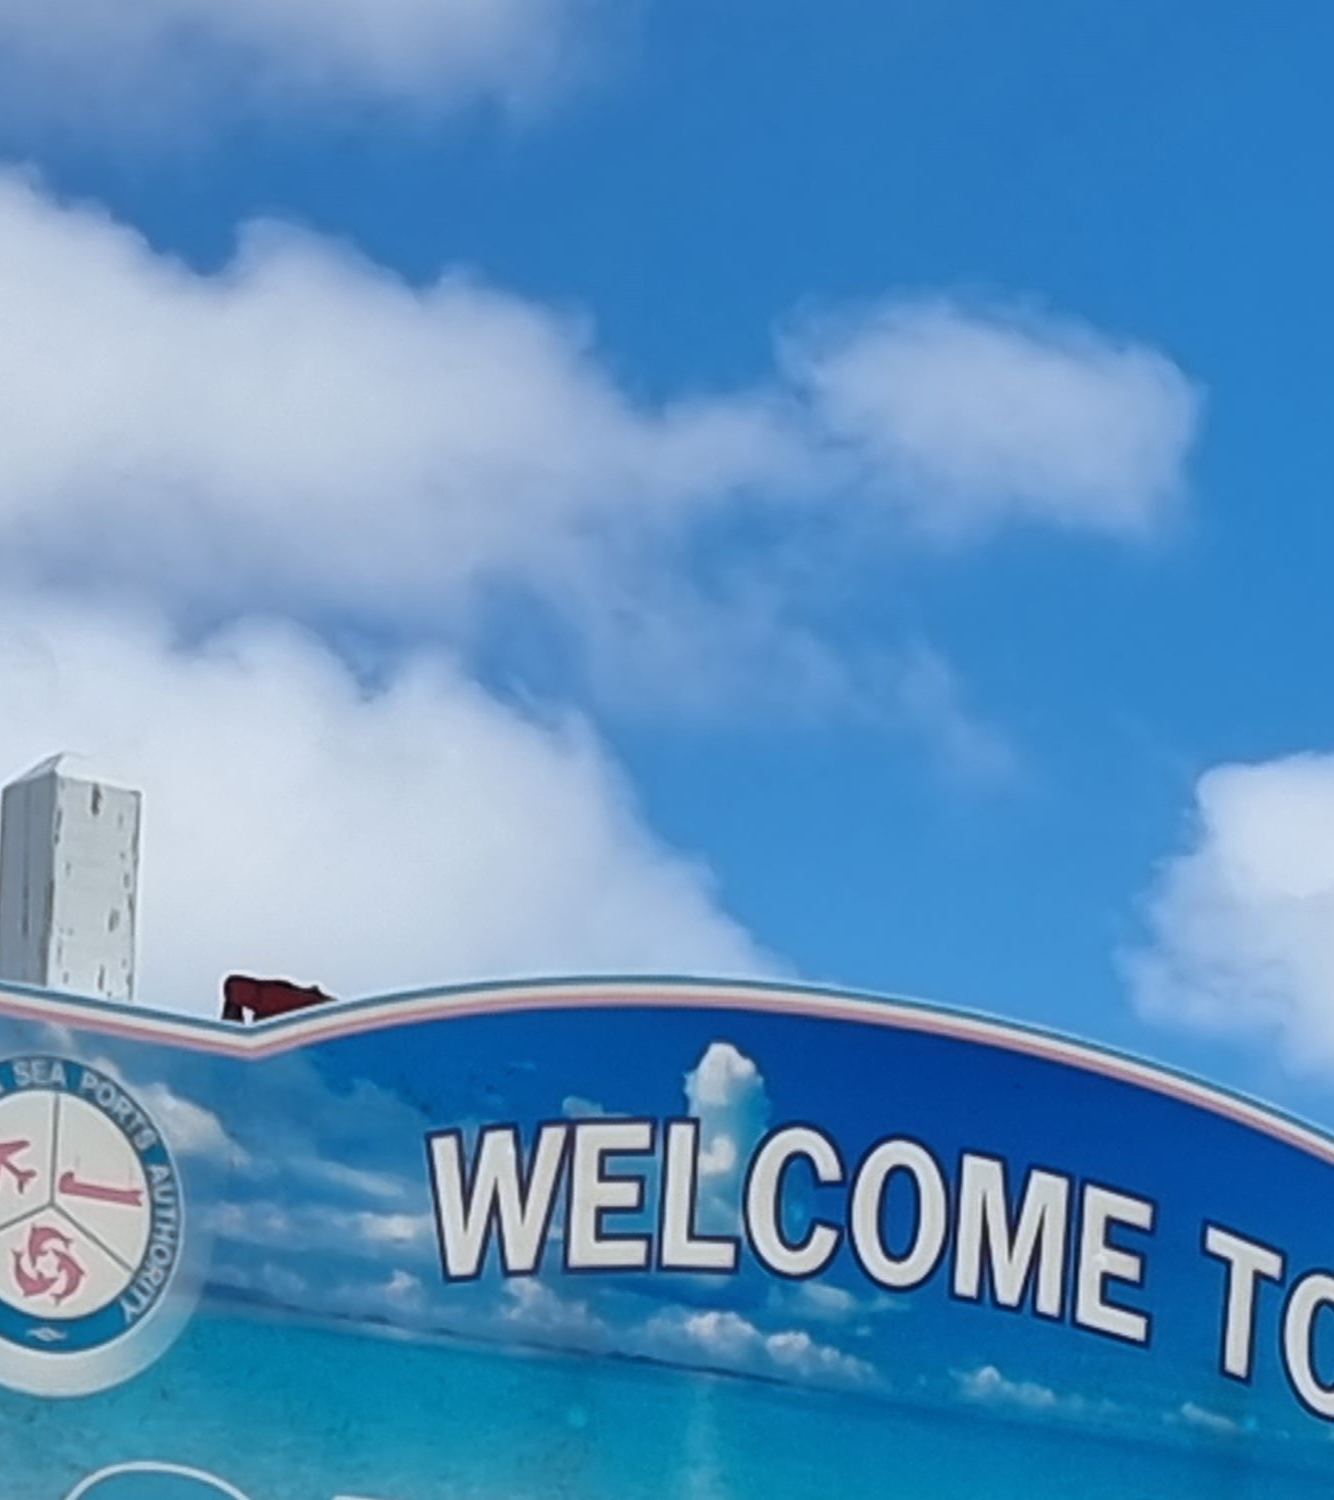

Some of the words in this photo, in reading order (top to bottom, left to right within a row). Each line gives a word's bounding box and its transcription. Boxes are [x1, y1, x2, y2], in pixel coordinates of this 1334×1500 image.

[11, 1060, 67, 1088] SEA
[78, 1071, 158, 1150] PORTS
[121, 1164, 178, 1324] AUTHORITY
[427, 1117, 1155, 1347] WELCOME
